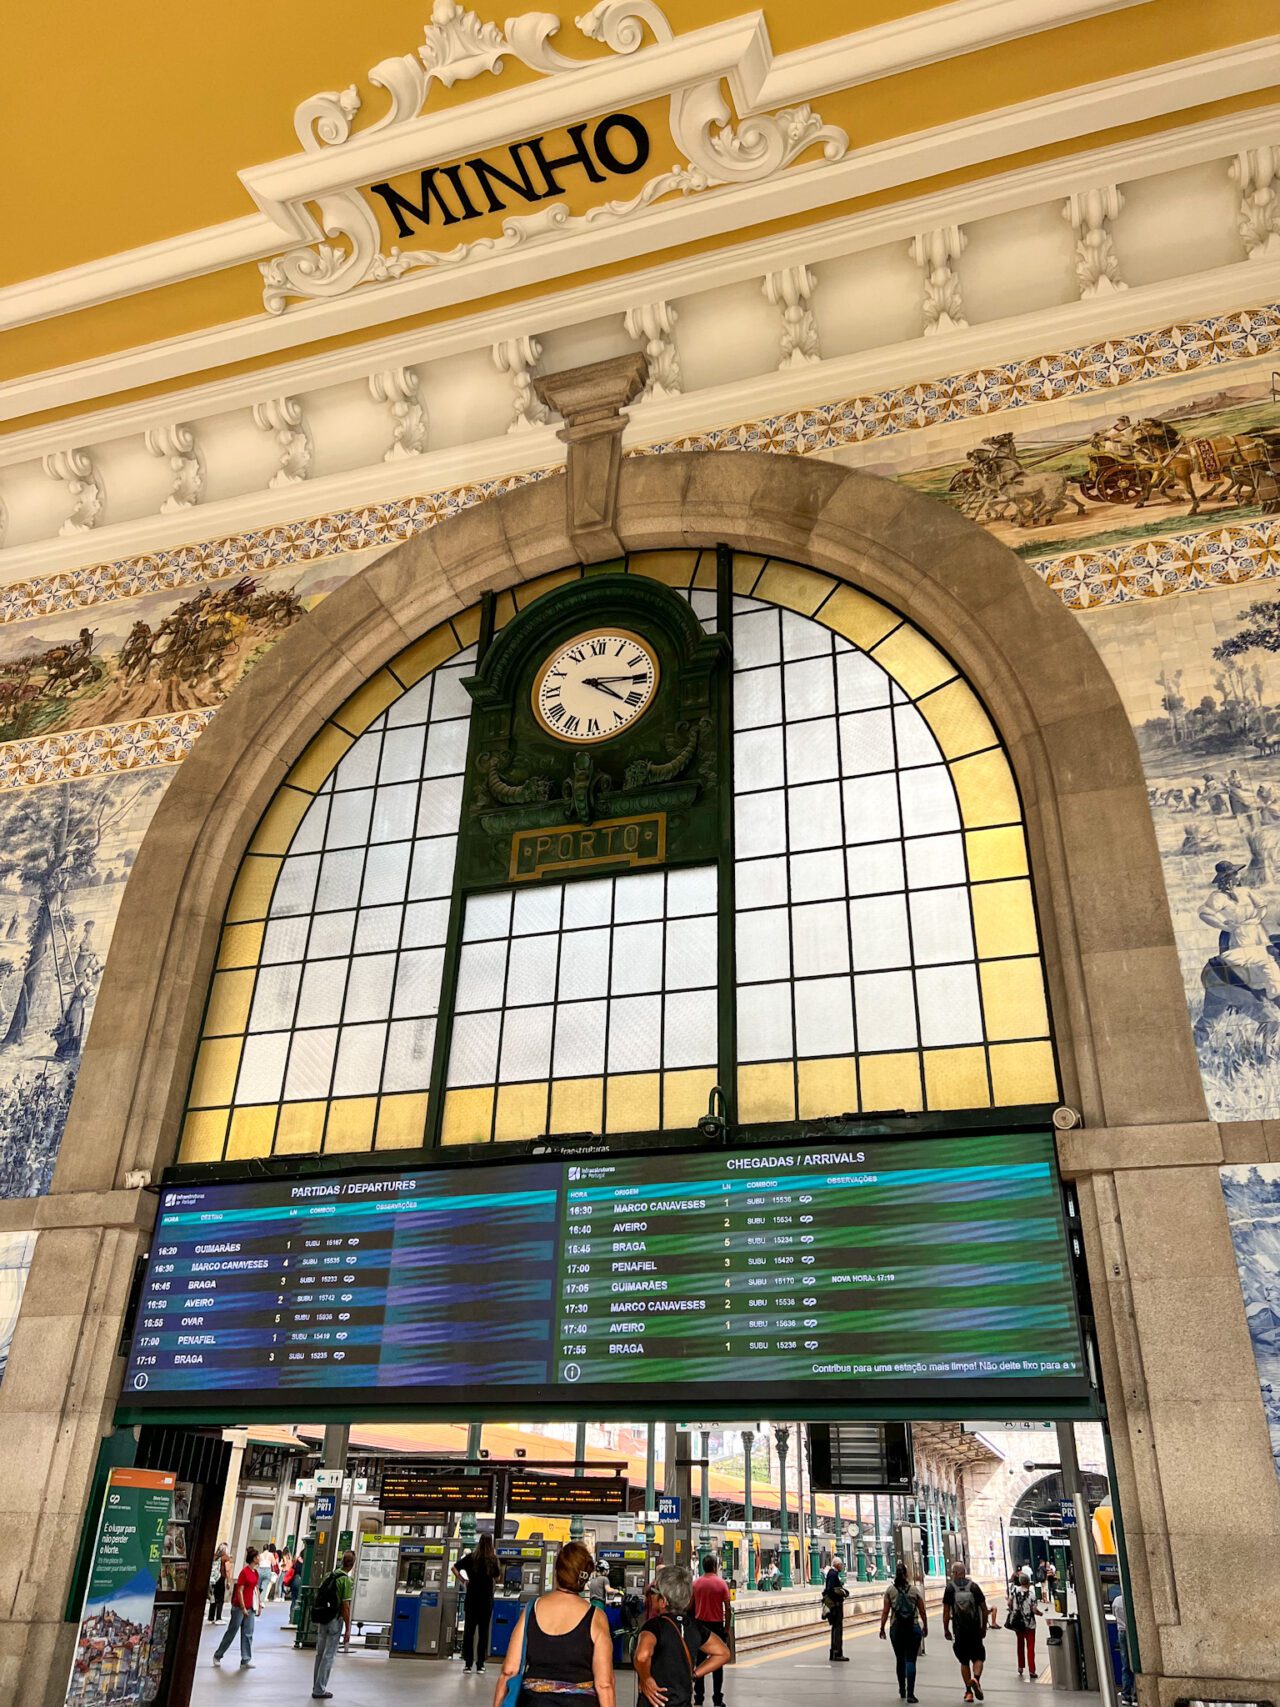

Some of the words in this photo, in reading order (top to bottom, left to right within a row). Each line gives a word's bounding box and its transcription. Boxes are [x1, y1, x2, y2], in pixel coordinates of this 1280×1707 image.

[371, 113, 650, 239] MINHO
[536, 824, 640, 864] PORTO
[726, 1156, 794, 1170] CHEGADAS
[796, 1155, 802, 1166] /
[803, 1152, 866, 1166] ARRIVALS
[291, 1184, 341, 1198] PARTIDAS
[347, 1179, 417, 1194] DEPARTURES
[614, 1188, 639, 1196] ORIGEM
[746, 1180, 778, 1188] COMBOIO
[569, 1206, 593, 1216] 16:30
[613, 1203, 648, 1213] MARCO
[650, 1200, 706, 1211] CANAVESES
[724, 1198, 730, 1207] 1
[746, 1197, 765, 1205] SUBU
[568, 1224, 592, 1234] 16:40
[613, 1222, 648, 1233] AVEIRO
[724, 1218, 730, 1227] 2
[747, 1217, 766, 1225] SUBU
[158, 1246, 178, 1255] 16:20
[194, 1243, 241, 1254] GUIMARÃES
[286, 1240, 292, 1249] 1
[568, 1244, 591, 1254] 16:45
[612, 1242, 646, 1252] BRAGA
[724, 1238, 730, 1247] 5
[747, 1237, 766, 1245] SUBU
[154, 1264, 174, 1273] 16:30
[191, 1262, 221, 1272] MARCO
[221, 1259, 269, 1270] CANAVESES
[282, 1258, 289, 1268] 4
[567, 1264, 590, 1274] 17:00
[611, 1261, 657, 1272] PENAFIEL
[724, 1258, 731, 1267] 3
[747, 1257, 767, 1265] SUBU
[151, 1282, 171, 1291] 16:45
[187, 1279, 217, 1290] BRAGA
[280, 1277, 286, 1286] 3
[565, 1283, 589, 1293] 17:05
[611, 1280, 668, 1292] GUIMARÃES
[724, 1278, 731, 1288] 4
[748, 1278, 767, 1286] SUBU
[831, 1274, 851, 1283] NOVA
[147, 1300, 168, 1309] 16:50
[184, 1298, 215, 1308] AVEIRO
[277, 1295, 284, 1304] 2
[565, 1303, 589, 1313] 17:30
[610, 1303, 646, 1313] MARCO
[648, 1300, 706, 1311] CANAVESES
[725, 1299, 731, 1309] 2
[748, 1299, 768, 1307] SUBU
[143, 1318, 164, 1328] 16:55
[181, 1316, 204, 1327] OVAR
[274, 1313, 281, 1323] 5
[294, 1313, 310, 1321] SUBU
[563, 1323, 588, 1334] 17:40
[609, 1322, 646, 1333] AVEIRO
[725, 1320, 731, 1330] 1
[749, 1320, 768, 1328] SUBU
[139, 1337, 160, 1346] 17:00
[177, 1335, 217, 1345] PENAFIEL
[272, 1333, 277, 1342] 1
[562, 1344, 587, 1355] 17:55
[608, 1343, 645, 1354] BRAGA
[725, 1342, 731, 1351] 1
[749, 1341, 769, 1349] SUBU
[135, 1356, 157, 1365] 17:15
[173, 1354, 204, 1364] BRAGA
[268, 1352, 275, 1362] 3
[288, 1352, 305, 1360] SUBU
[811, 1363, 852, 1373] Contribua
[852, 1364, 873, 1374] para
[893, 1362, 927, 1374] estação
[928, 1362, 950, 1371] mais
[950, 1361, 978, 1373] limpa!
[979, 1360, 998, 1371] Não
[999, 1360, 1021, 1371] deite
[1021, 1360, 1039, 1370] lixo
[1040, 1361, 1061, 1372] para
[316, 1502, 332, 1512] PRT1
[659, 1504, 677, 1514] PRT1
[112, 1524, 125, 1534] lugar
[101, 1535, 112, 1543] não
[111, 1535, 129, 1545] perder
